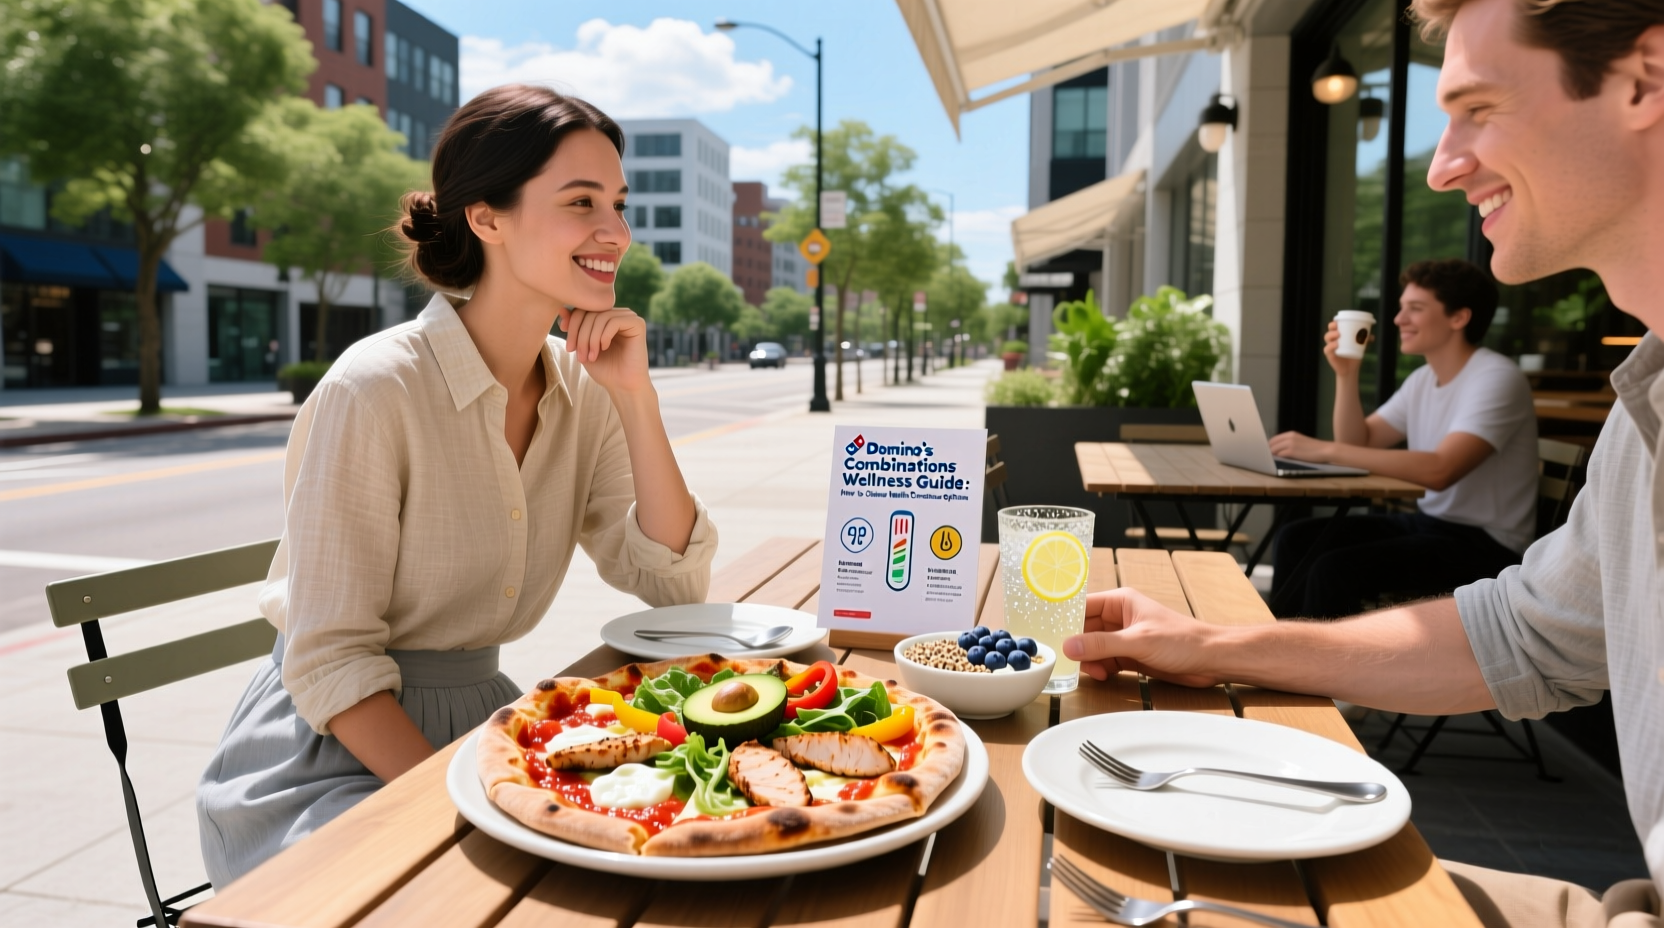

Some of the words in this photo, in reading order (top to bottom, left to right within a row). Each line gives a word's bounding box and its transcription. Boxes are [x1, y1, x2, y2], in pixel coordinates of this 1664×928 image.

[867, 441, 934, 456] Domino's
[844, 457, 957, 473] Combinations
[843, 473, 912, 488] Wellness
[916, 475, 970, 490] Guide:
